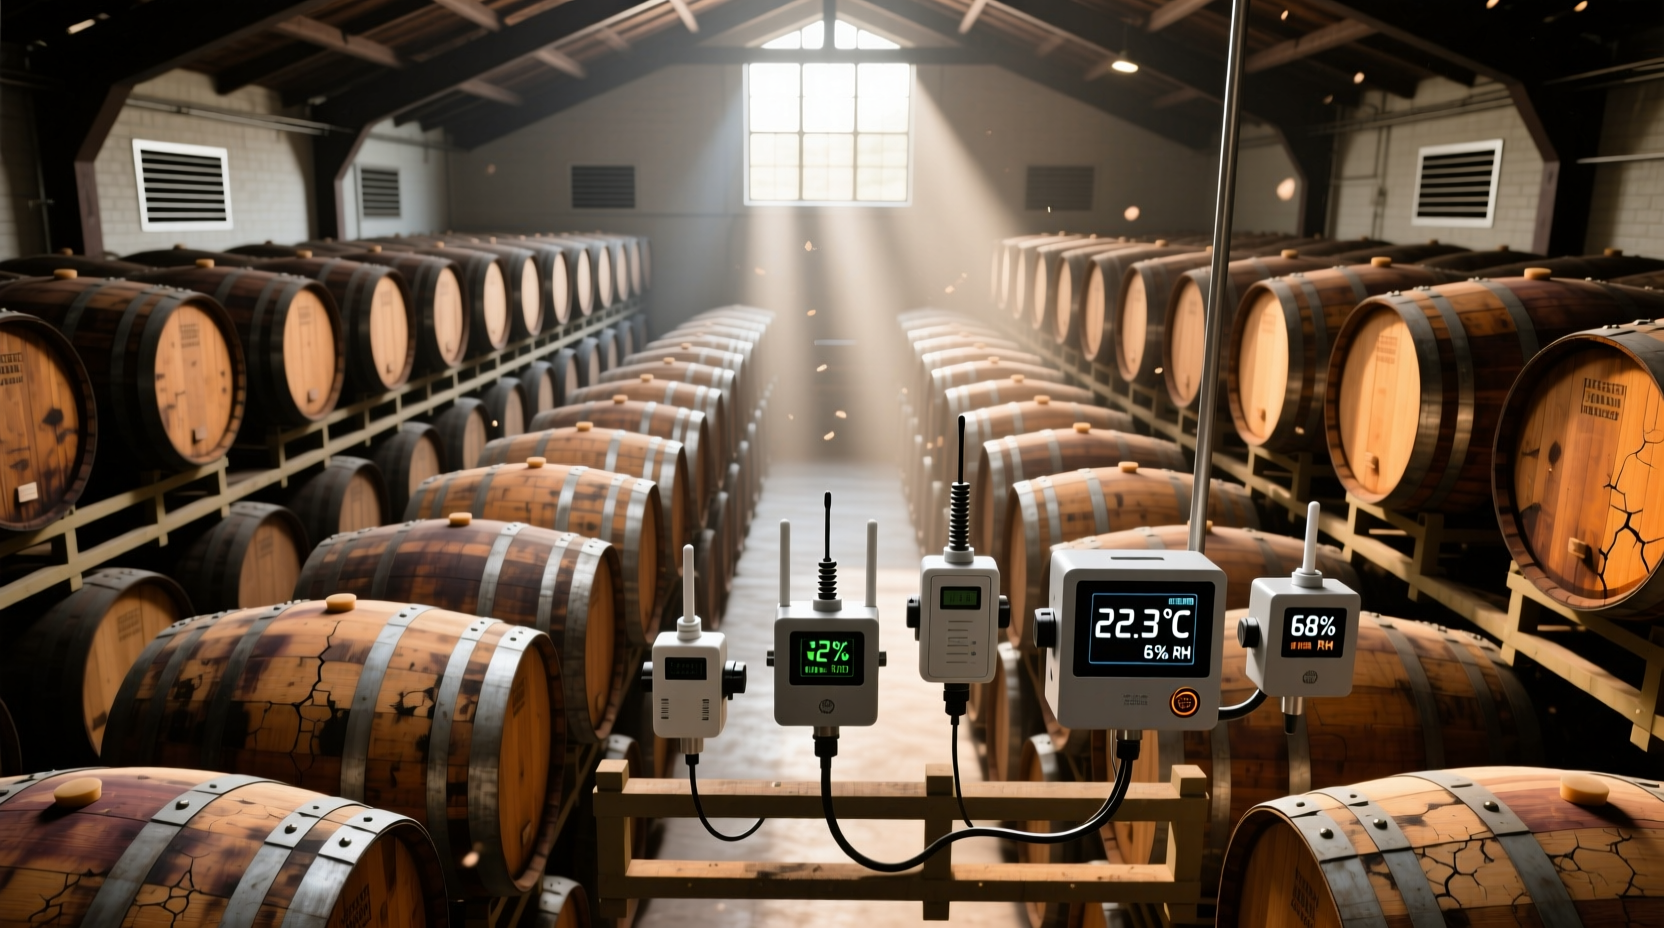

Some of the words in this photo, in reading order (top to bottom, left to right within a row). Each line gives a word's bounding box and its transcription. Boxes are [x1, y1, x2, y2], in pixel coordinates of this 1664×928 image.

[1095, 608, 1191, 638] 22.3°C
[1291, 614, 1336, 636] 68%
[1143, 644, 1169, 660] 6%
[1172, 645, 1191, 660] RH
[1316, 639, 1334, 651] RH
